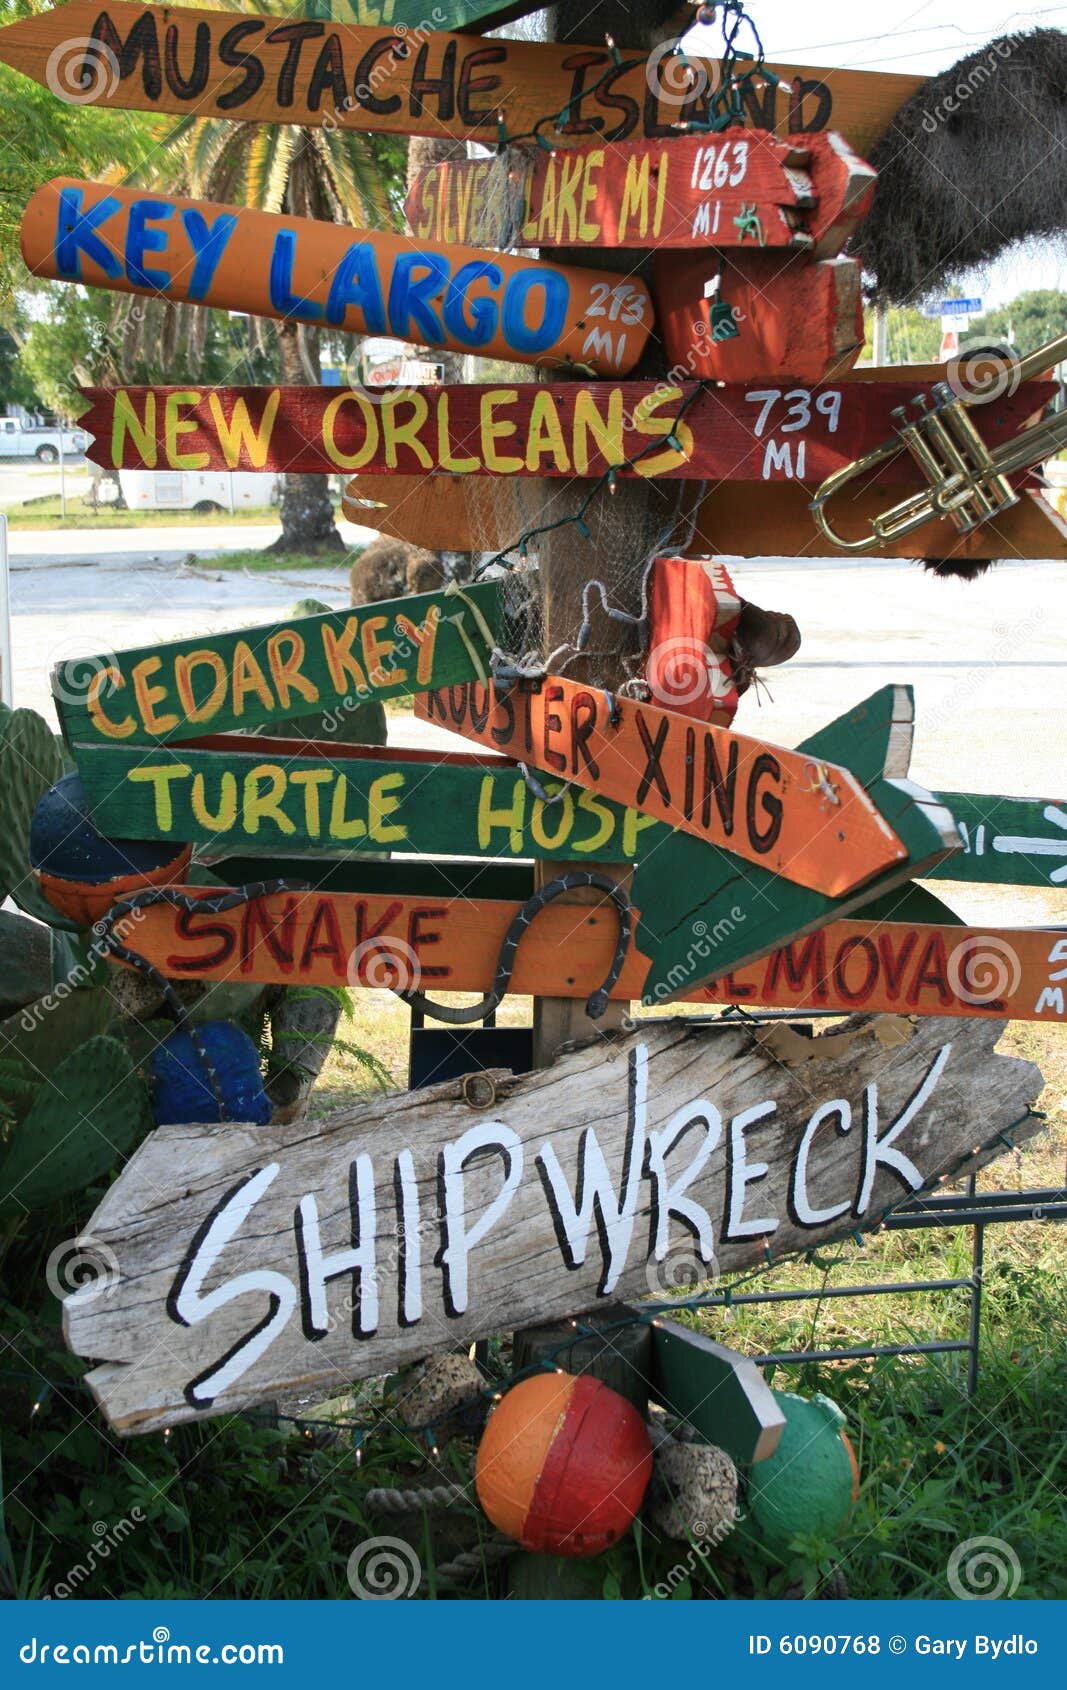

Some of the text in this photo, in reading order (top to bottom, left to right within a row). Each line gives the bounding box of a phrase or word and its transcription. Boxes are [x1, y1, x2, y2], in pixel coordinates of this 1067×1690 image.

[80, 11, 833, 142] MUSTACHE ISLAND
[522, 150, 605, 245] LAKE
[617, 152, 669, 244] MI
[691, 141, 749, 190] 1263
[692, 200, 721, 239] MI
[55, 187, 570, 355] KEY LARGO
[582, 326, 627, 369] MI
[112, 388, 694, 478] NEW ORLEANS
[745, 389, 842, 437] 739
[762, 439, 806, 480] MI
[87, 604, 440, 739] CEDAR KEY
[127, 764, 410, 843] TURTLE
[478, 776, 680, 858] HOSP
[635, 709, 784, 854] XING
[167, 889, 1007, 1012] SNAKE MOVAL
[166, 1043, 952, 1409] SHIPWRECK
